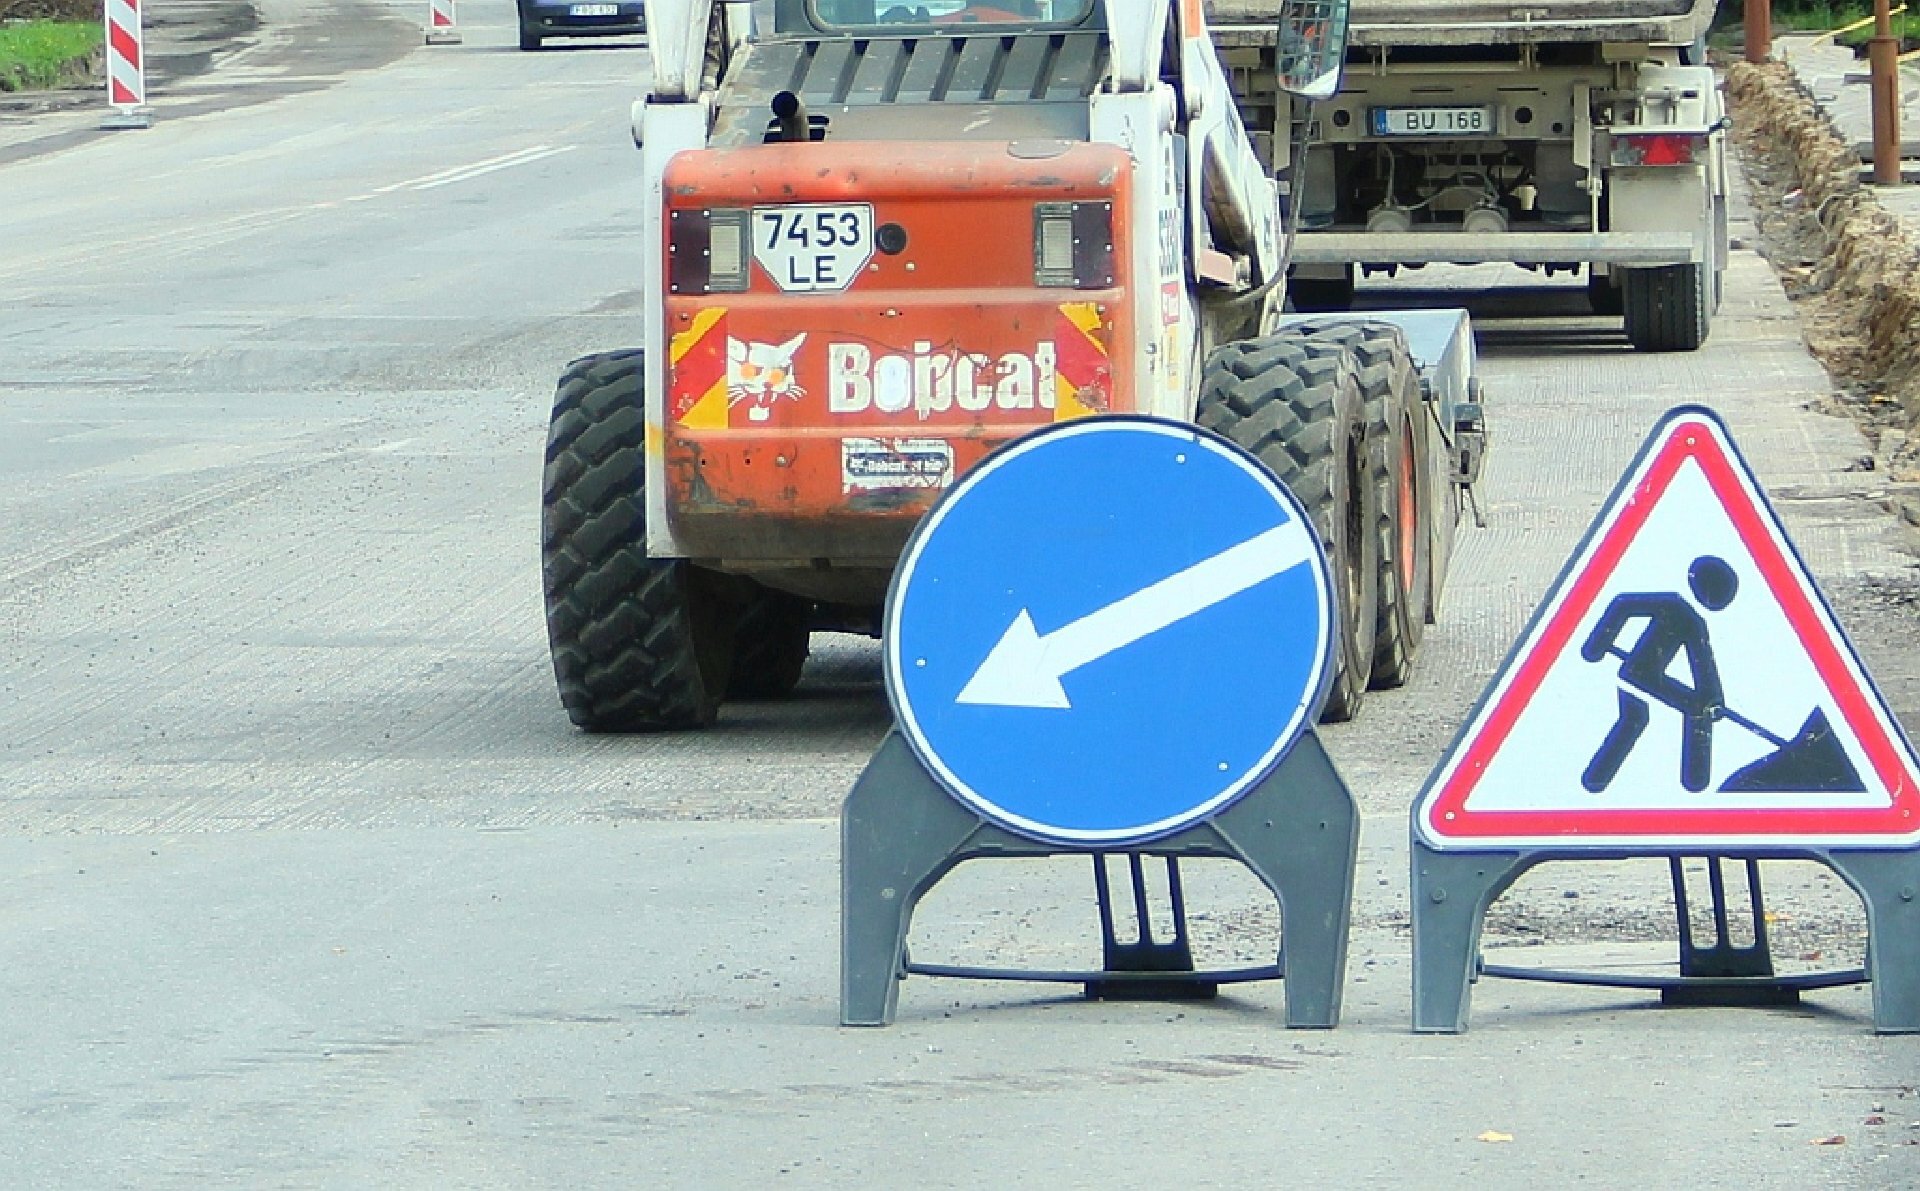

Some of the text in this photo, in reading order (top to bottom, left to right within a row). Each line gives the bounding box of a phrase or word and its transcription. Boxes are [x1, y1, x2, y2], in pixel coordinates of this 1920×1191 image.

[1406, 111, 1436, 130] BU
[1447, 111, 1481, 130] 168
[763, 212, 861, 249] 7453
[789, 255, 837, 284] LE
[828, 340, 1056, 420] Bobcat
